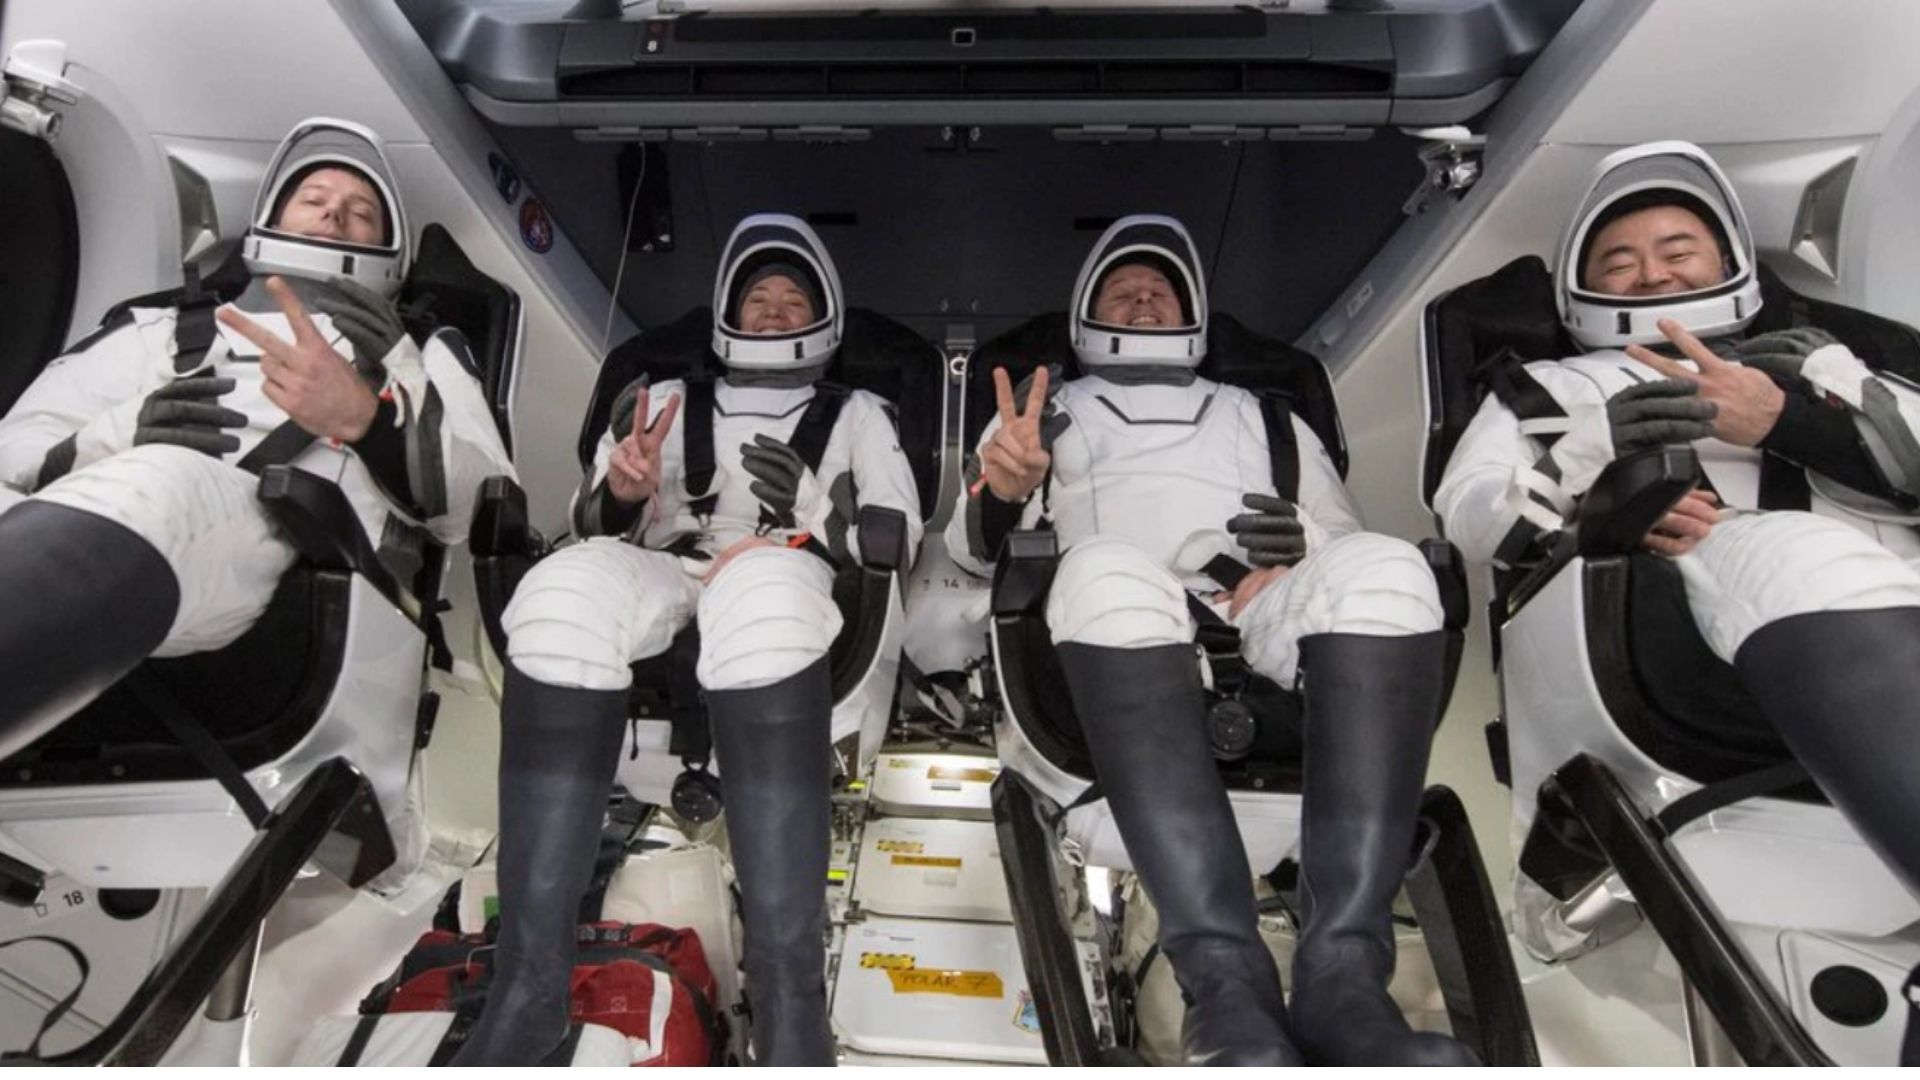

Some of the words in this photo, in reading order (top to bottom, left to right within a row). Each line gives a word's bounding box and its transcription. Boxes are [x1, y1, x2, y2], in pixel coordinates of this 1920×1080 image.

[944, 579, 960, 589] 14
[62, 890, 84, 906] 18
[901, 973, 957, 988] POLAR
